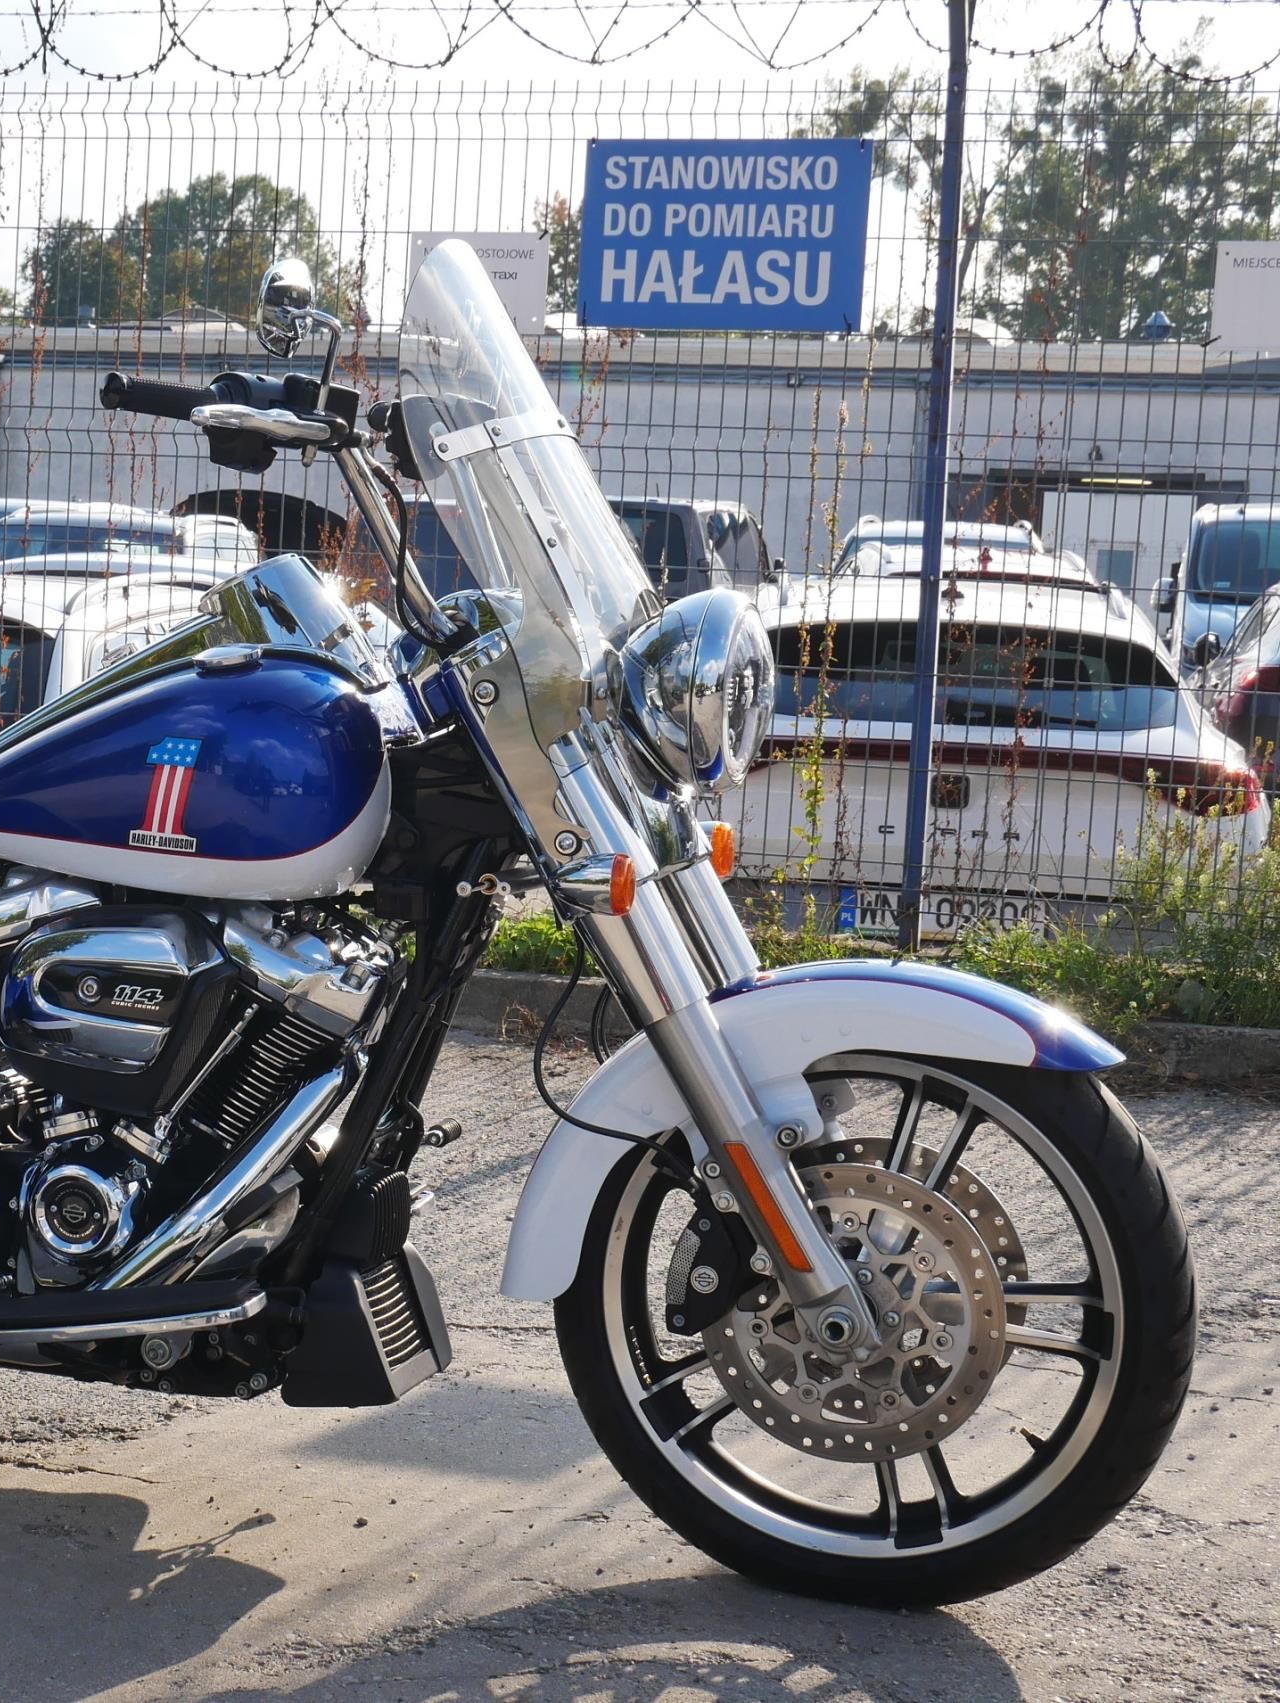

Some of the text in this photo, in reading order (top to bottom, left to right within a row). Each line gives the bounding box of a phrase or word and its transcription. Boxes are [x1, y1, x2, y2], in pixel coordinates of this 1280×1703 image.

[604, 155, 839, 190] STANOWISKO
[603, 203, 835, 238] DO POMIARU
[476, 248, 535, 260] OSTOJOWE
[600, 249, 832, 306] HAŁASU
[130, 832, 195, 850] HARLEY-DAVIDSON
[878, 824, 1021, 842] CPRA
[840, 911, 854, 922] PL
[860, 892, 901, 927] WN
[113, 984, 165, 1005] 114
